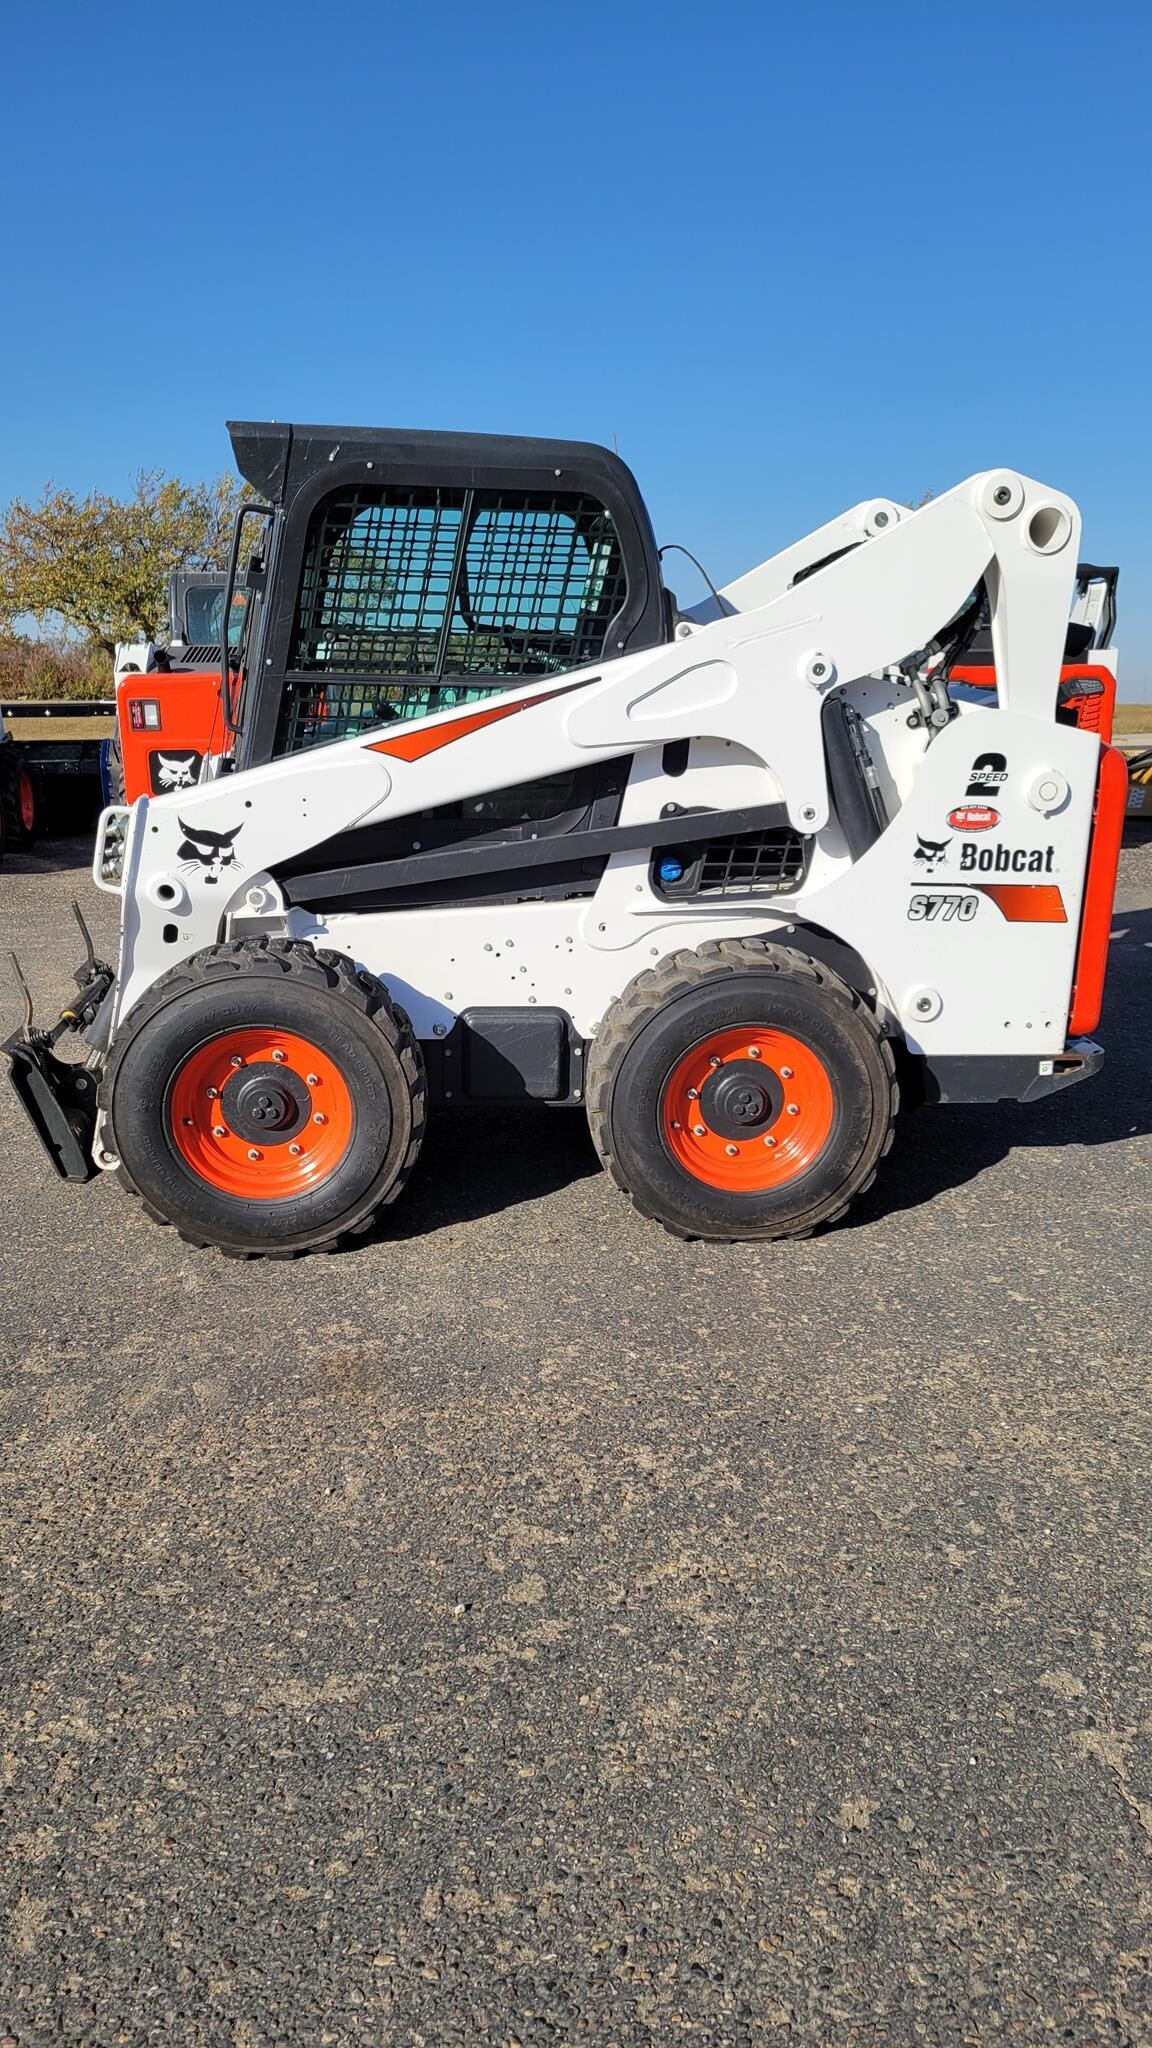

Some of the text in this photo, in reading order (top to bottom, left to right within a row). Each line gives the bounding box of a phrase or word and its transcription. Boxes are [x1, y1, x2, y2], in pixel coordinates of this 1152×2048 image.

[965, 752, 1008, 797] 2 SPEED
[960, 843, 1055, 873] Bobcat
[907, 894, 979, 921] S770
